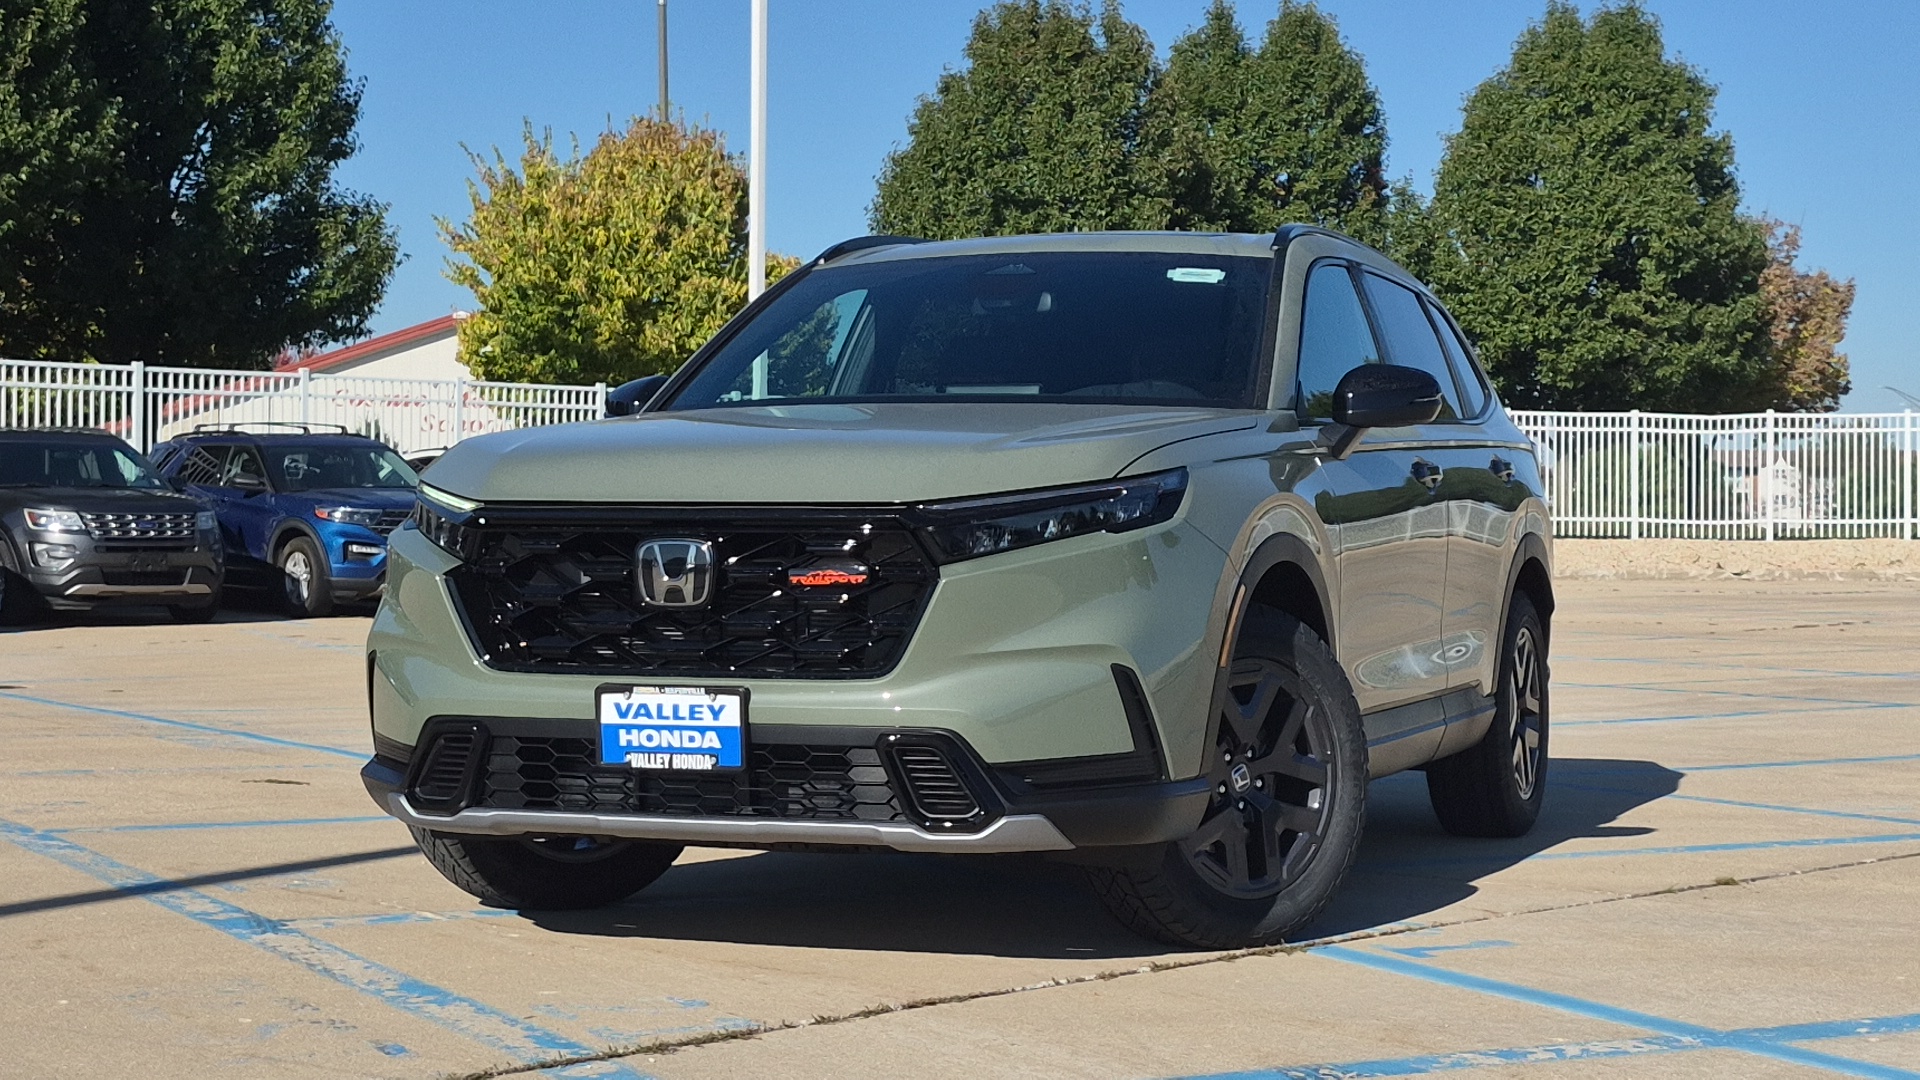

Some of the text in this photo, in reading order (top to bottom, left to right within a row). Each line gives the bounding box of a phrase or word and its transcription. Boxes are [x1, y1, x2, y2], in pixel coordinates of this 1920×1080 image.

[789, 574, 868, 586] TRAILSPORT
[613, 702, 727, 721] VALLEY
[618, 728, 723, 749] HONDA
[630, 752, 712, 770] VALLEY HONDA
